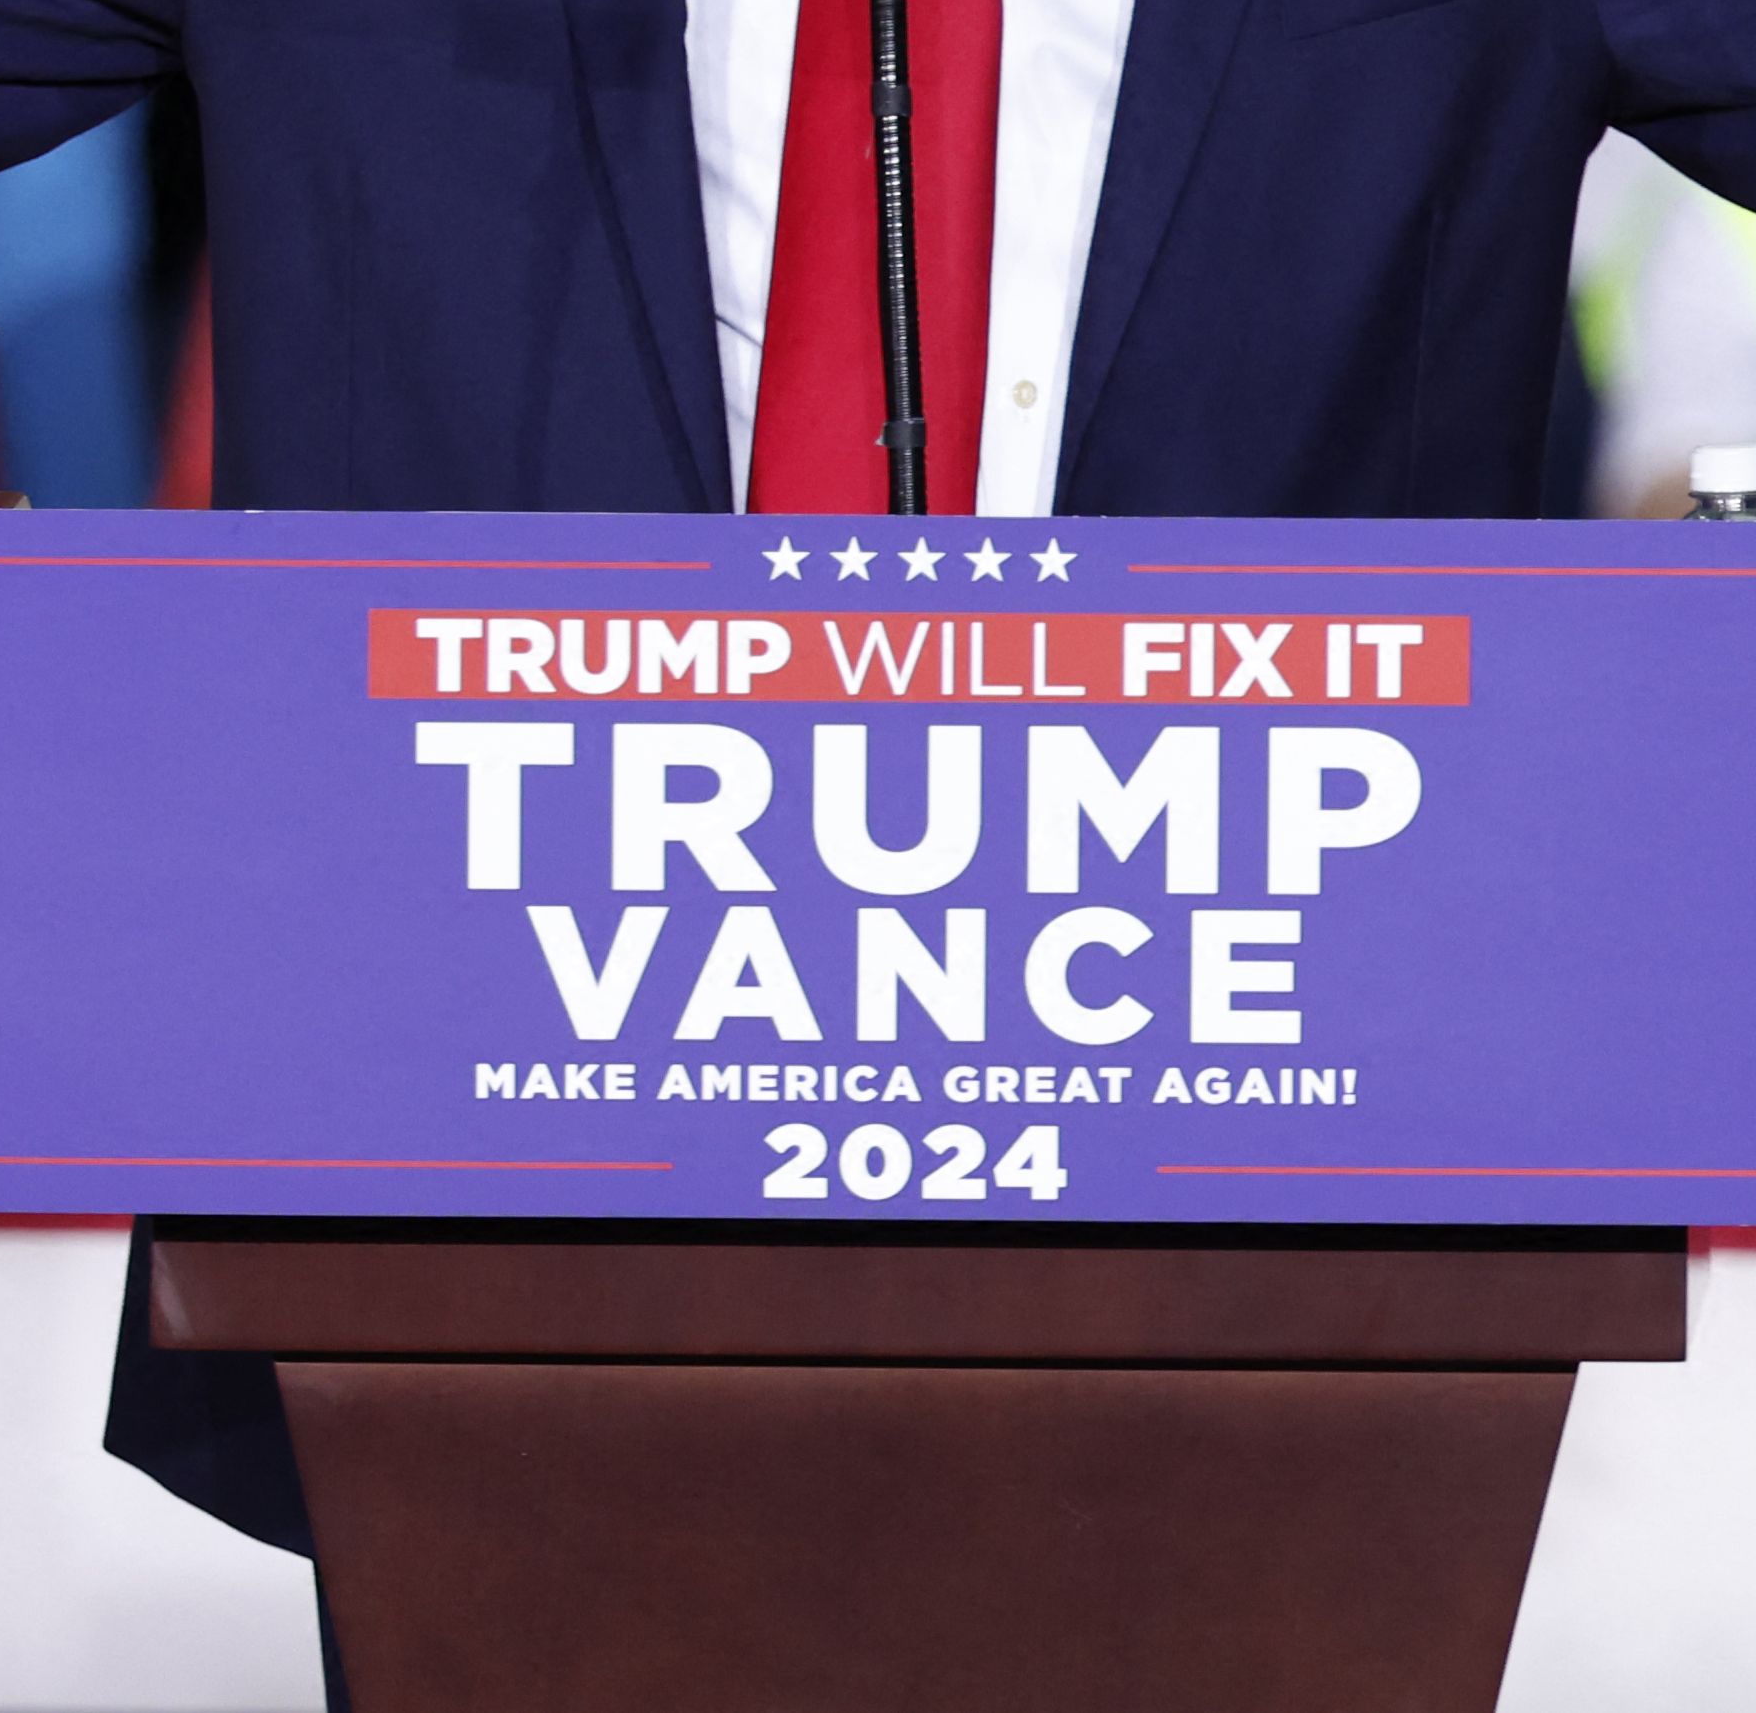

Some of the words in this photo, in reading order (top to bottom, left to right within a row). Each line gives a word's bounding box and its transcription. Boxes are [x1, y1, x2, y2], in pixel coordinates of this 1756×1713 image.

[416, 618, 792, 695] TRUMP
[822, 620, 1087, 696] WILL
[1123, 622, 1294, 698] FIX
[1326, 623, 1424, 699] IT
[415, 721, 1422, 896] TRUMP
[524, 905, 1303, 1046] VANCE
[475, 1063, 636, 1100] MAKE
[656, 1063, 922, 1102] AMERICA
[943, 1065, 1132, 1104] GREAT
[1152, 1067, 1357, 1105] AGAIN!
[763, 1123, 1069, 1201] 2024
